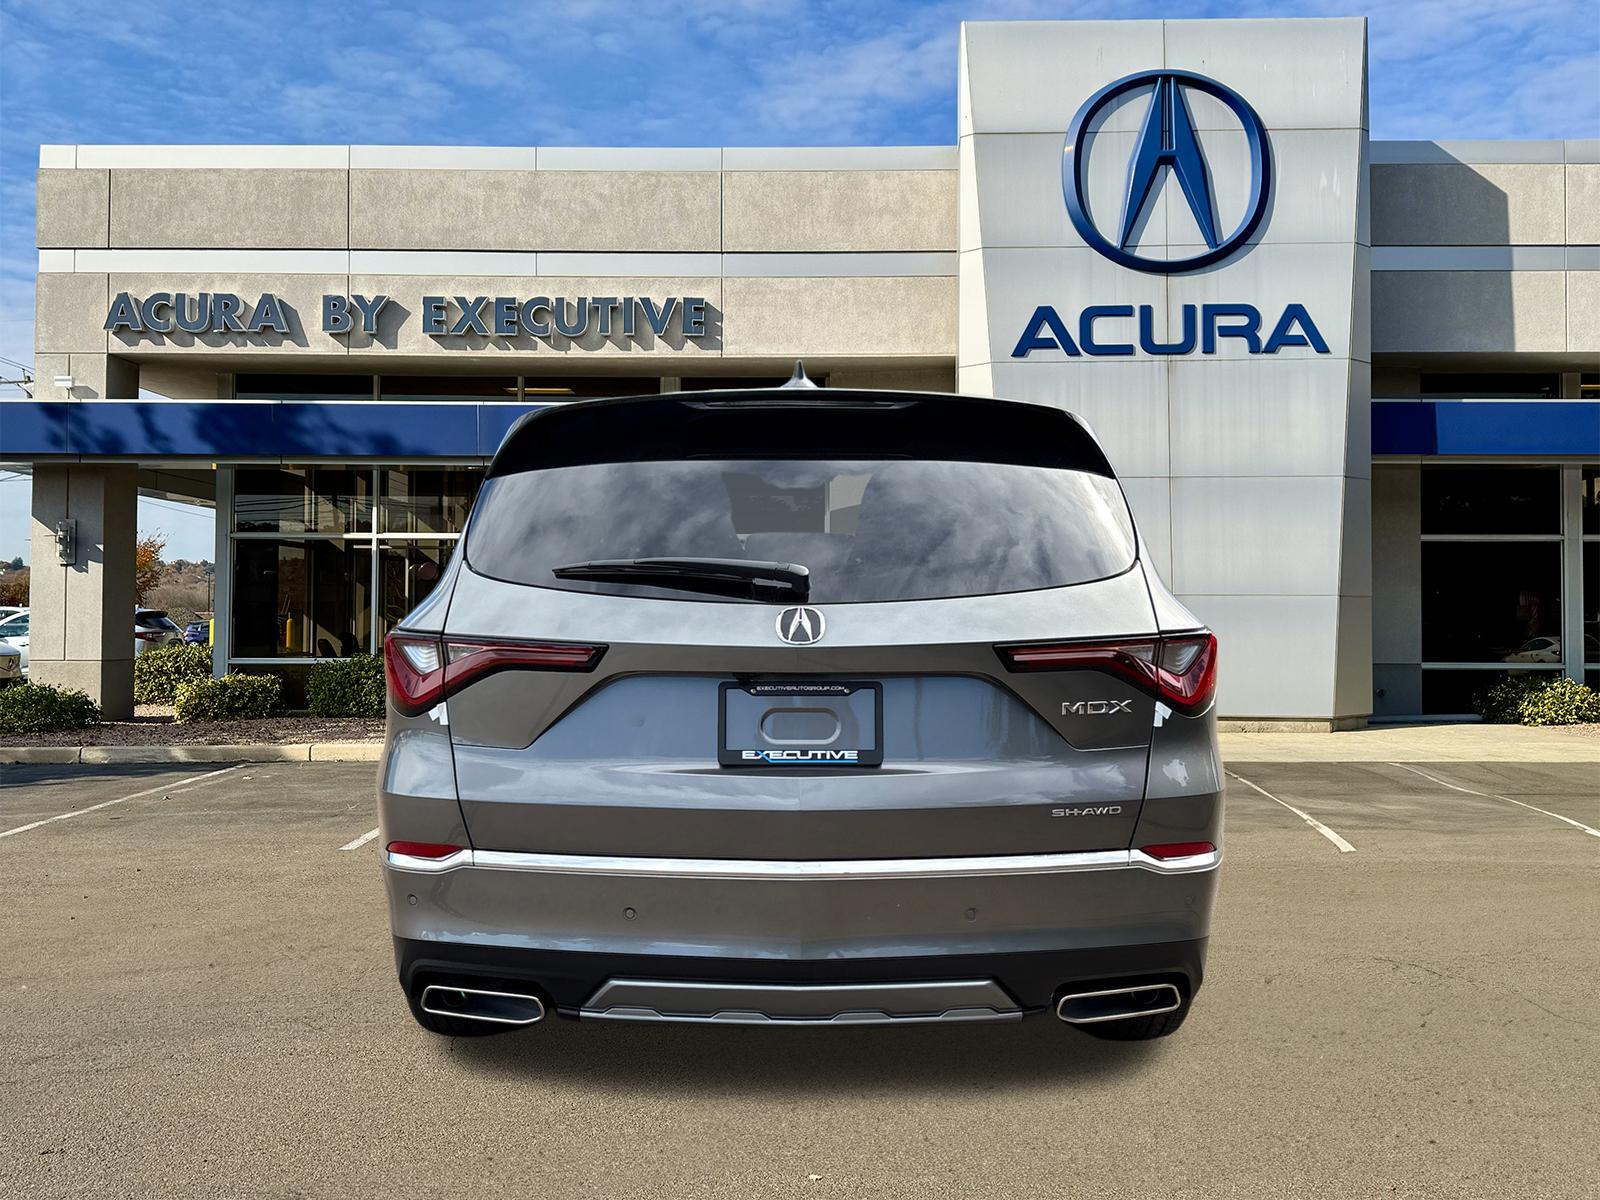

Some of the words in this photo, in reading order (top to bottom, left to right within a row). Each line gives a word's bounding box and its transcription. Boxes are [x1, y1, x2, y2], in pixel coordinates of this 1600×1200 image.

[103, 291, 290, 334] ACURA
[321, 294, 393, 335] BY
[422, 296, 707, 337] EXECUTIVE
[1011, 303, 1331, 357] ACURA
[1061, 700, 1132, 716] MDX
[742, 750, 858, 761] EXECUTIVE
[1051, 806, 1122, 817] SH-AWD
